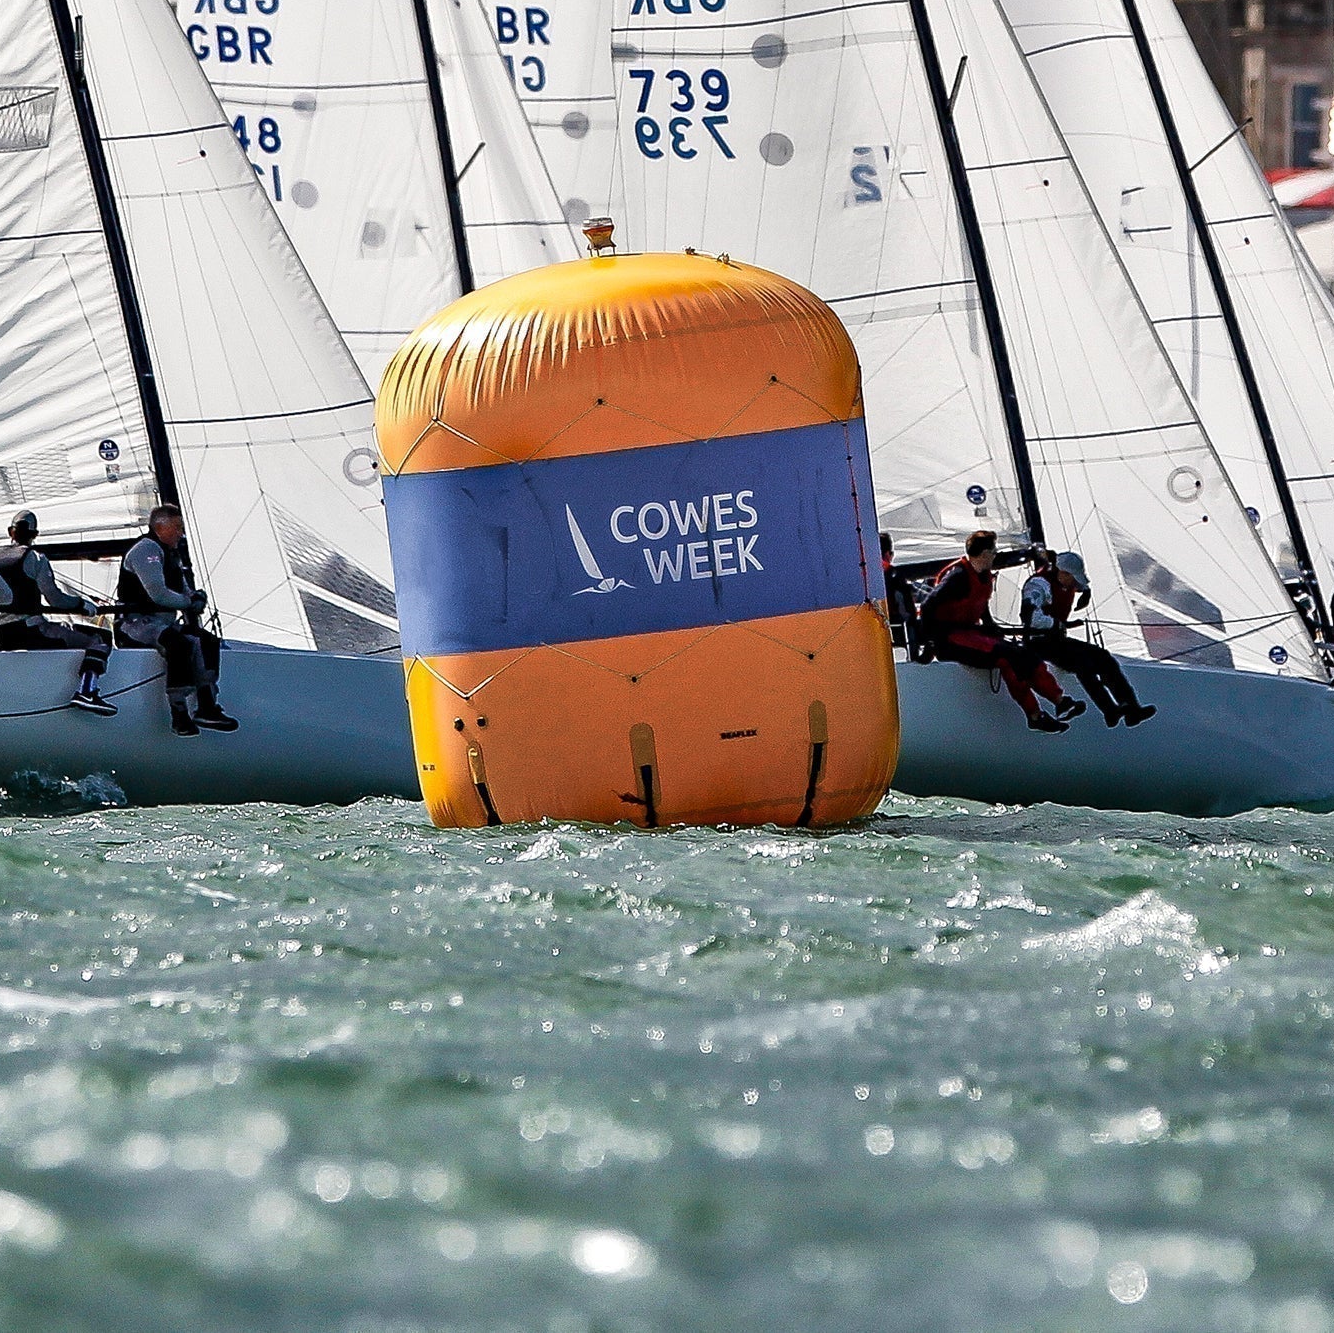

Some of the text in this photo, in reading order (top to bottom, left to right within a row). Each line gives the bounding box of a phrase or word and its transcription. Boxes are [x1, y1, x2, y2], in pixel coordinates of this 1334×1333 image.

[186, 24, 273, 66] GBR
[496, 5, 550, 45] BR
[629, 69, 731, 113] 739
[232, 115, 282, 154] 48
[610, 490, 758, 544] COWES
[642, 534, 765, 585] WEEK
